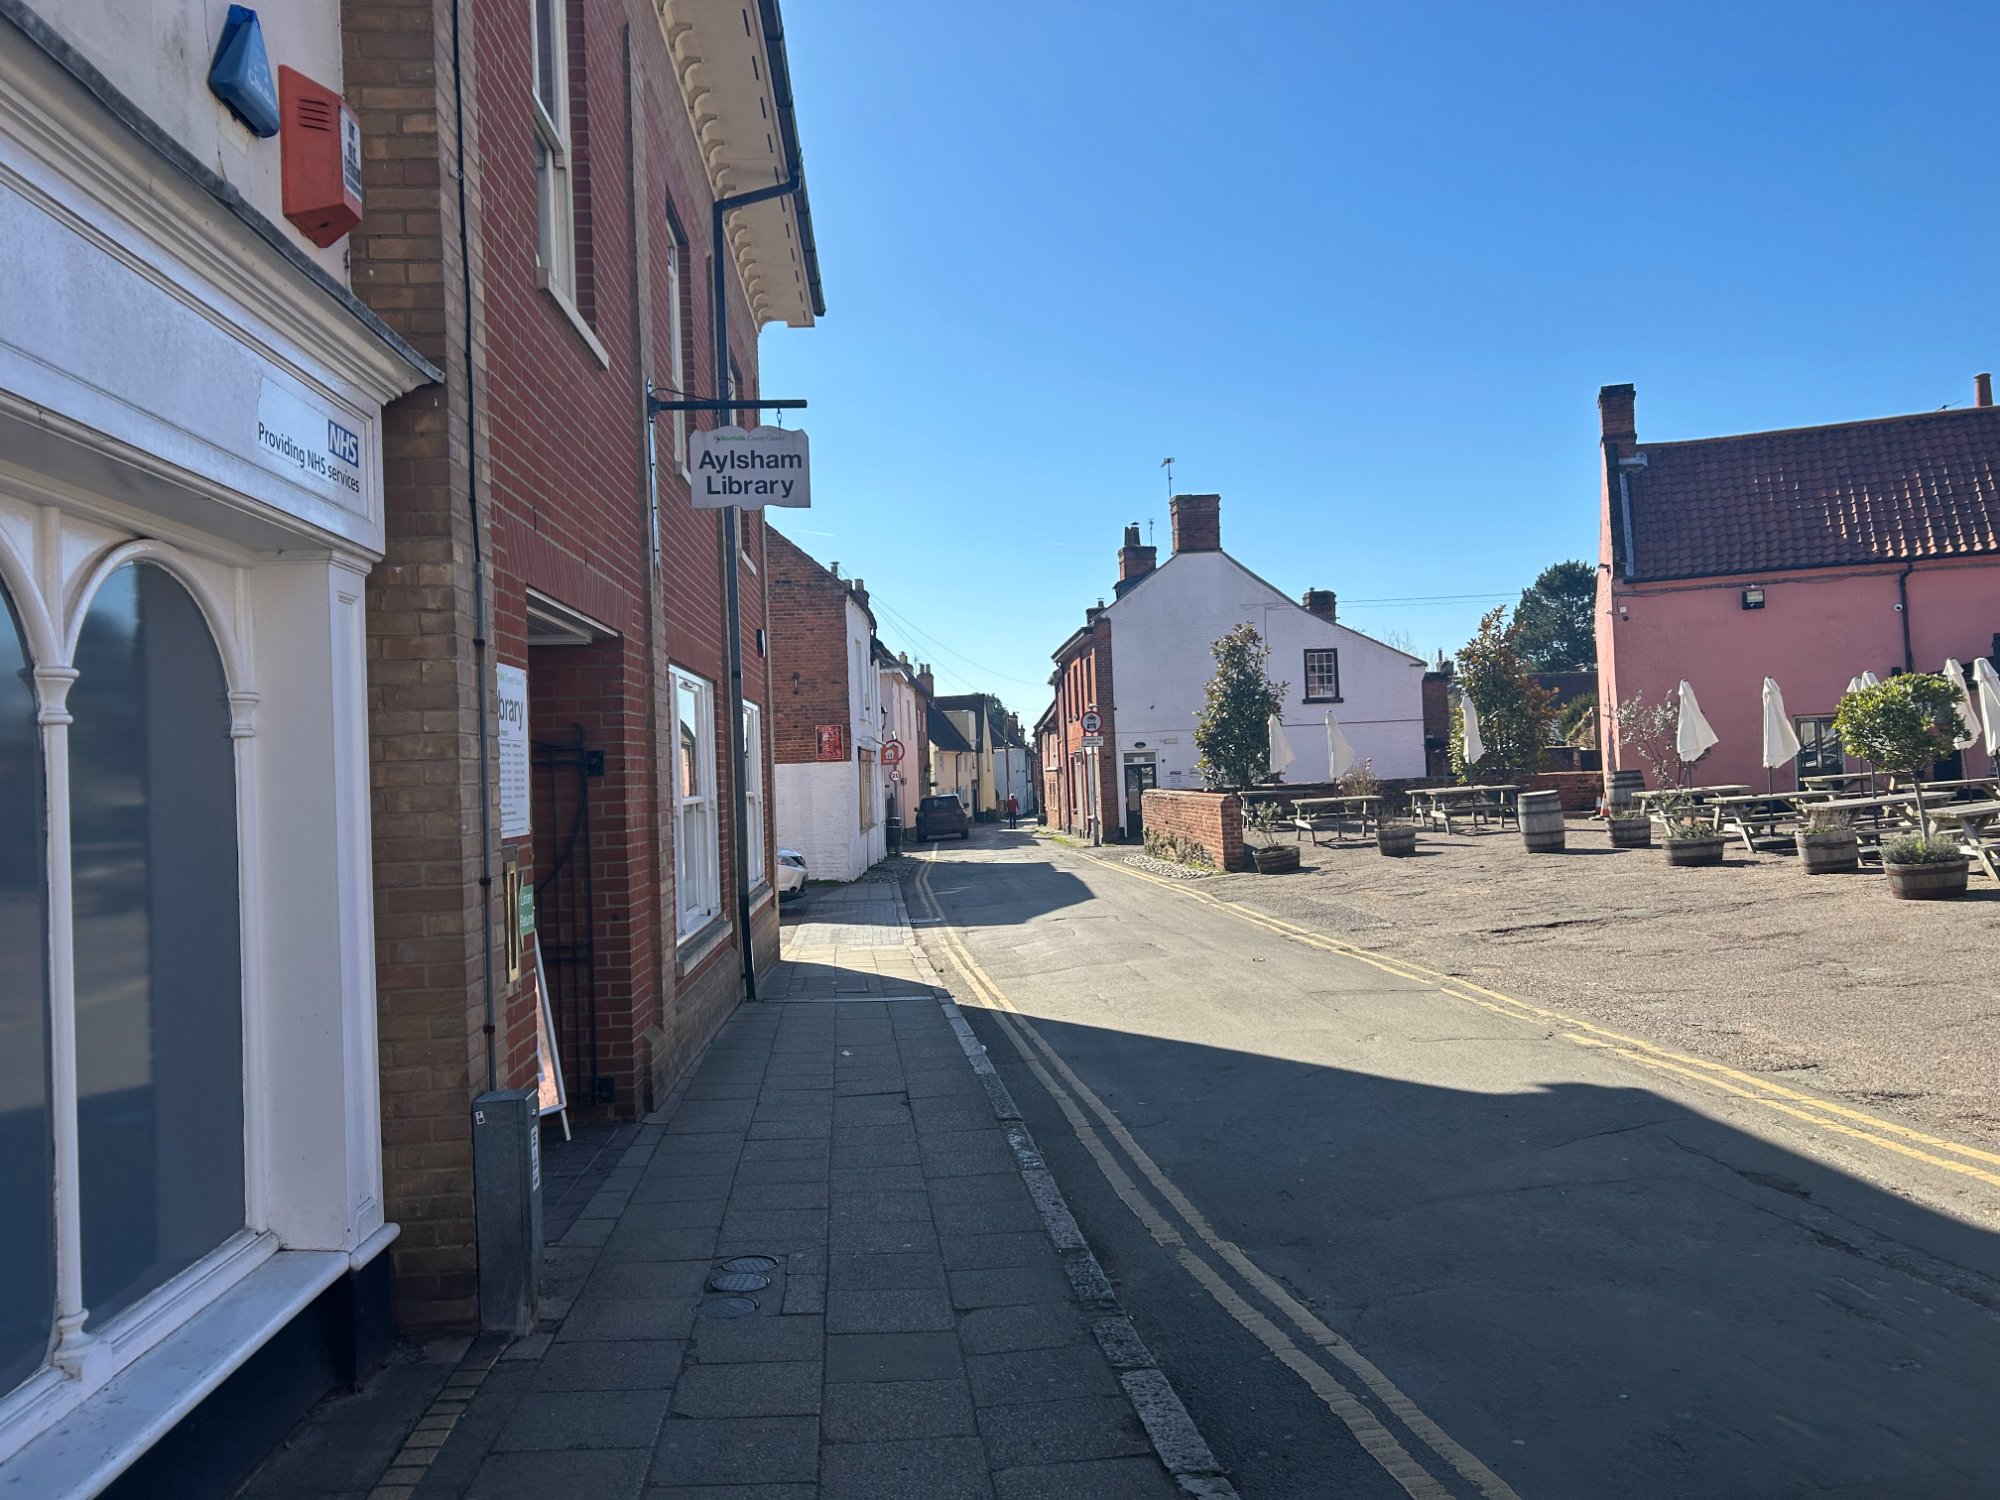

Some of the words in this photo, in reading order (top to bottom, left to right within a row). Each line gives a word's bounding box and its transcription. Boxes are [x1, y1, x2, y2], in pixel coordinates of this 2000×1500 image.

[258, 421, 305, 469] Providing
[307, 449, 326, 475] NHS
[328, 465, 360, 493] services
[329, 423, 358, 464] NHS
[699, 450, 802, 473] Aylsham
[706, 476, 794, 499] Library
[498, 690, 523, 731] brary
[521, 893, 533, 905] Library
